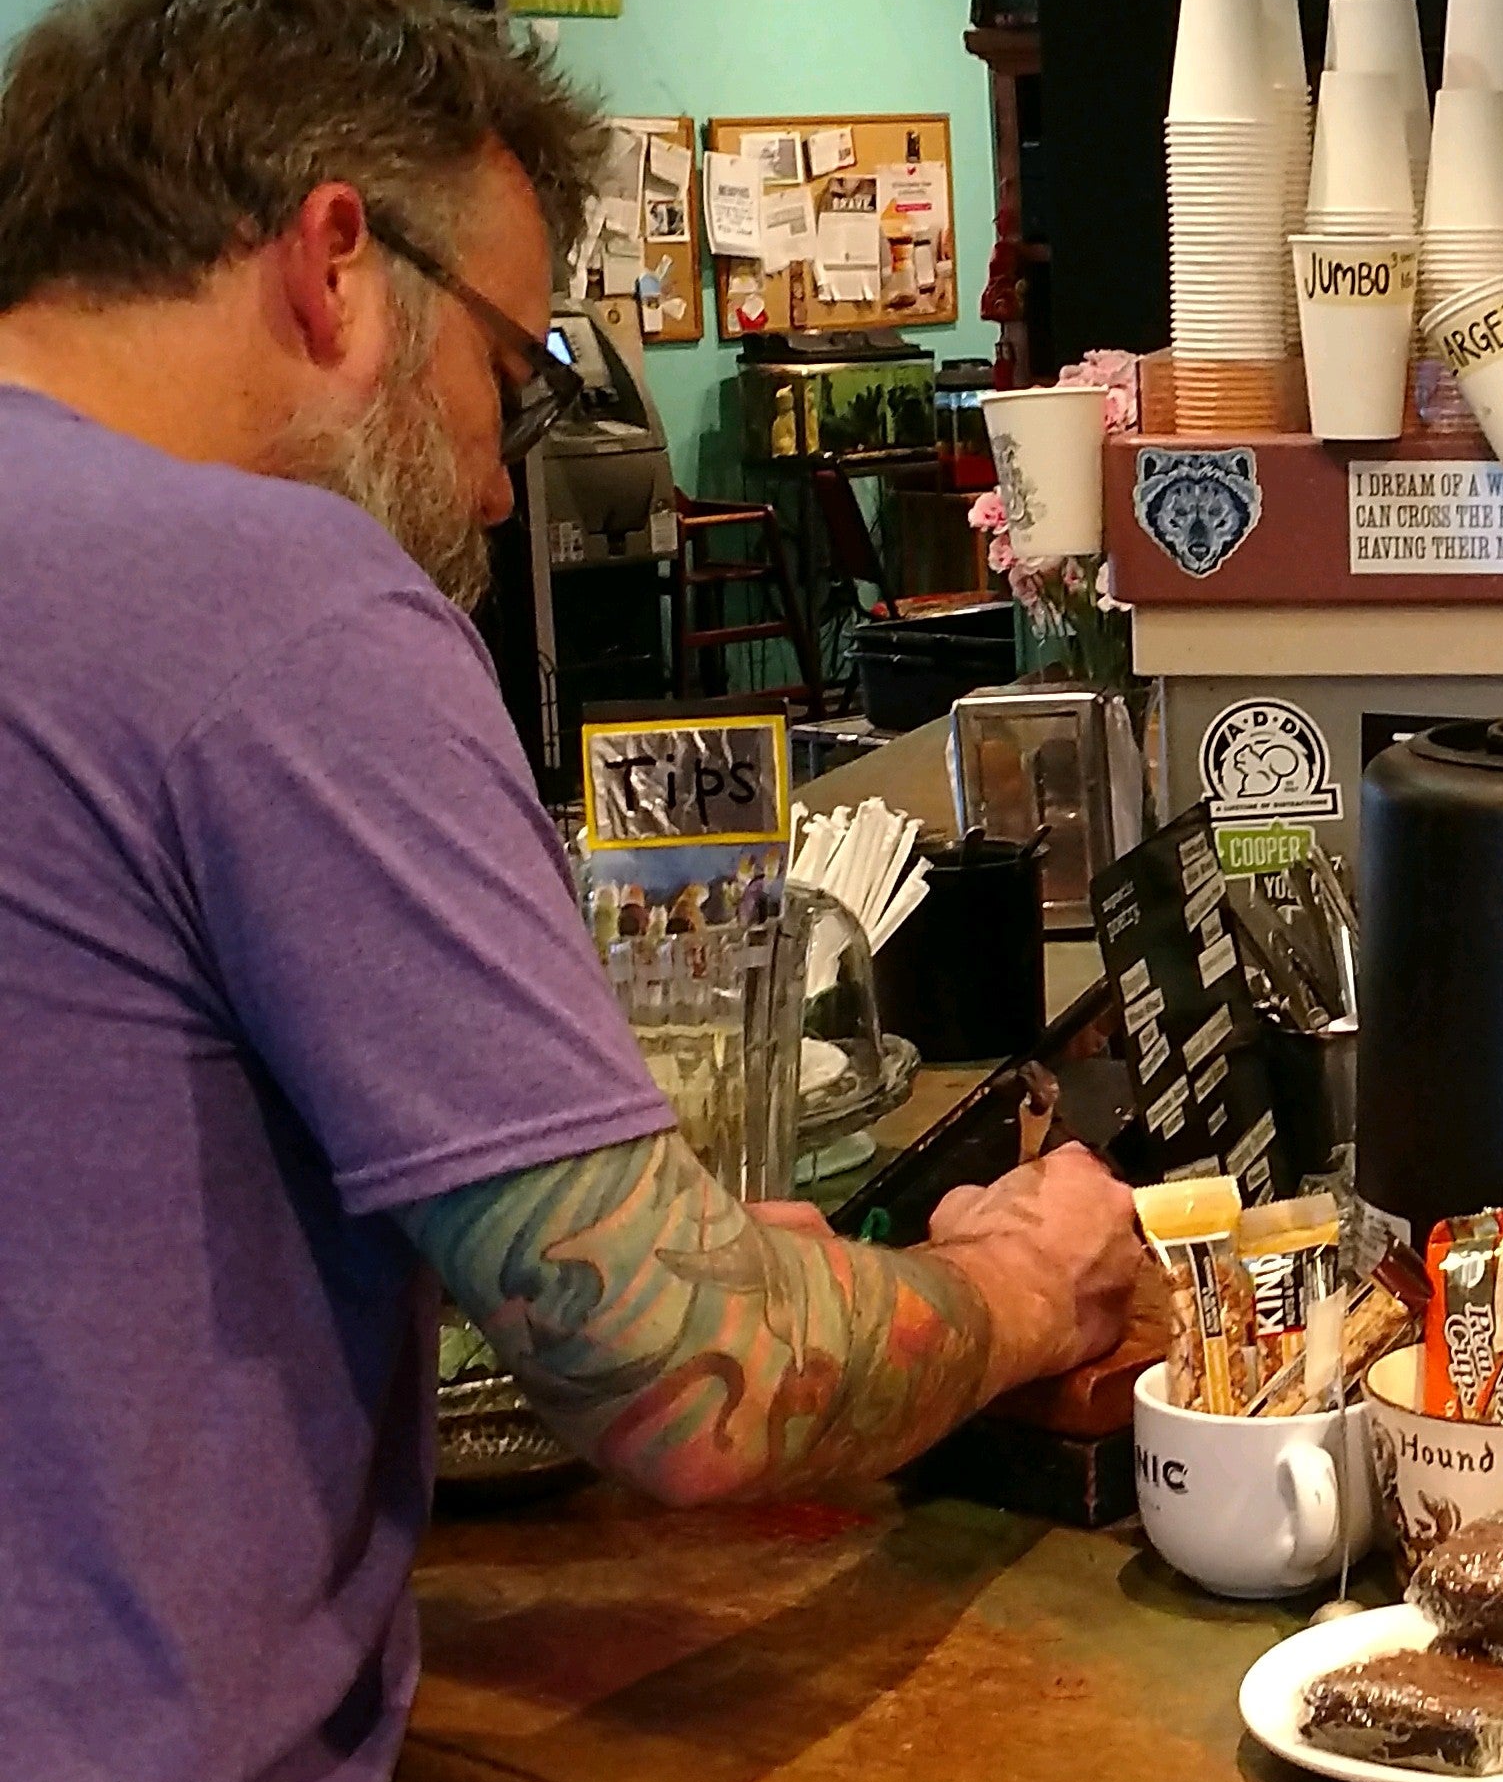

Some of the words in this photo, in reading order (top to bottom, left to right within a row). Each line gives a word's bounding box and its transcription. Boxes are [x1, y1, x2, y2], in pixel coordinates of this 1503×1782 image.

[1304, 251, 1391, 299] JUMBO
[1356, 474, 1362, 496] I
[1369, 474, 1436, 496] DREAM
[1440, 474, 1463, 496] OF
[1468, 474, 1479, 496] A
[1356, 506, 1392, 528] CAN
[1396, 506, 1451, 528] CROSS
[1455, 506, 1494, 528] THE
[1356, 537, 1426, 559] HAVING
[1431, 537, 1490, 559] THEIR
[605, 754, 755, 826] Tips
[1230, 835, 1300, 868] COOPER
[1401, 1432, 1494, 1473] Hound
